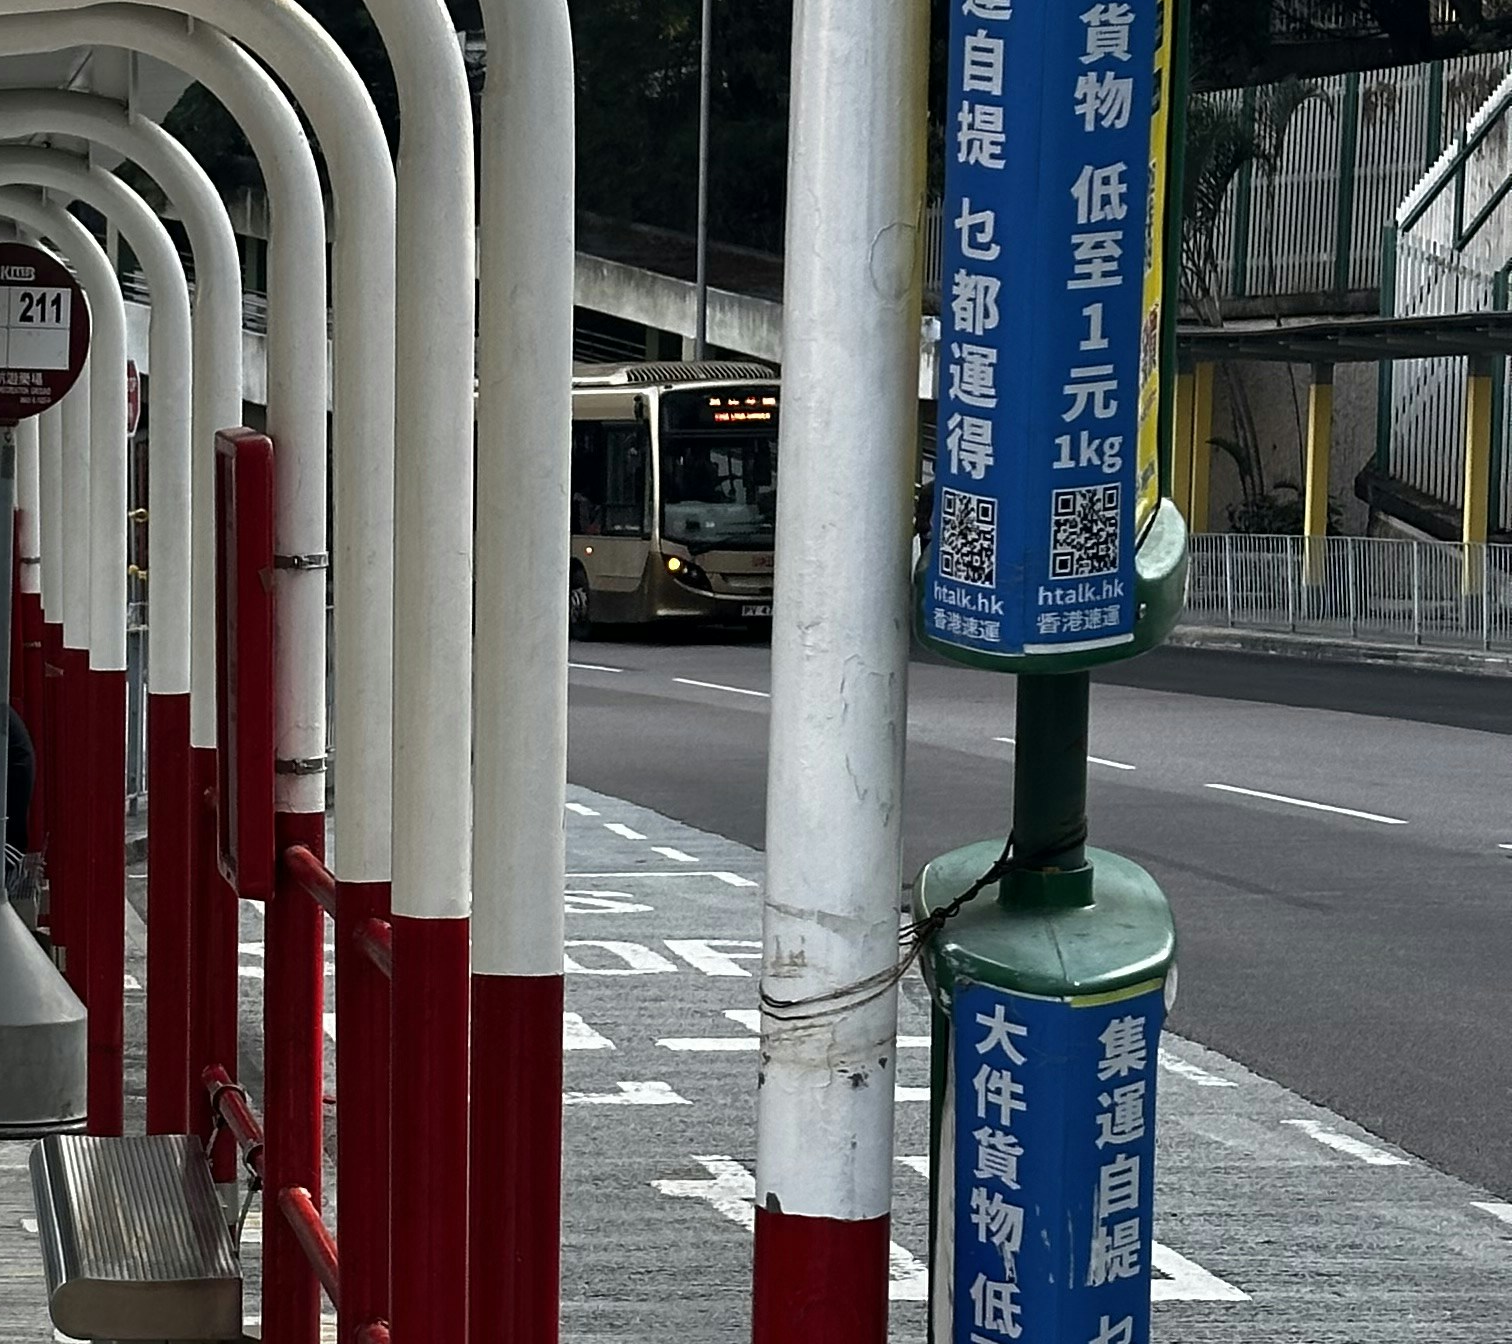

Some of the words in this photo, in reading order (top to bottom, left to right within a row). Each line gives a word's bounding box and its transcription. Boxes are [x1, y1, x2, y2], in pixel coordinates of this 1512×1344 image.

[19, 292, 62, 324] 211
[1062, 161, 1128, 423] 低至1元
[946, 197, 1002, 480] 乜都運得
[1052, 430, 1124, 474] 1kg
[933, 580, 1005, 616] htalk.hk
[1037, 578, 1126, 606] htalk.hk
[932, 608, 1002, 643] 香港速運
[1035, 604, 1122, 635] 香港速運
[968, 1003, 1028, 1254] 大件貨物
[1089, 1014, 1147, 1285] 集運自提
